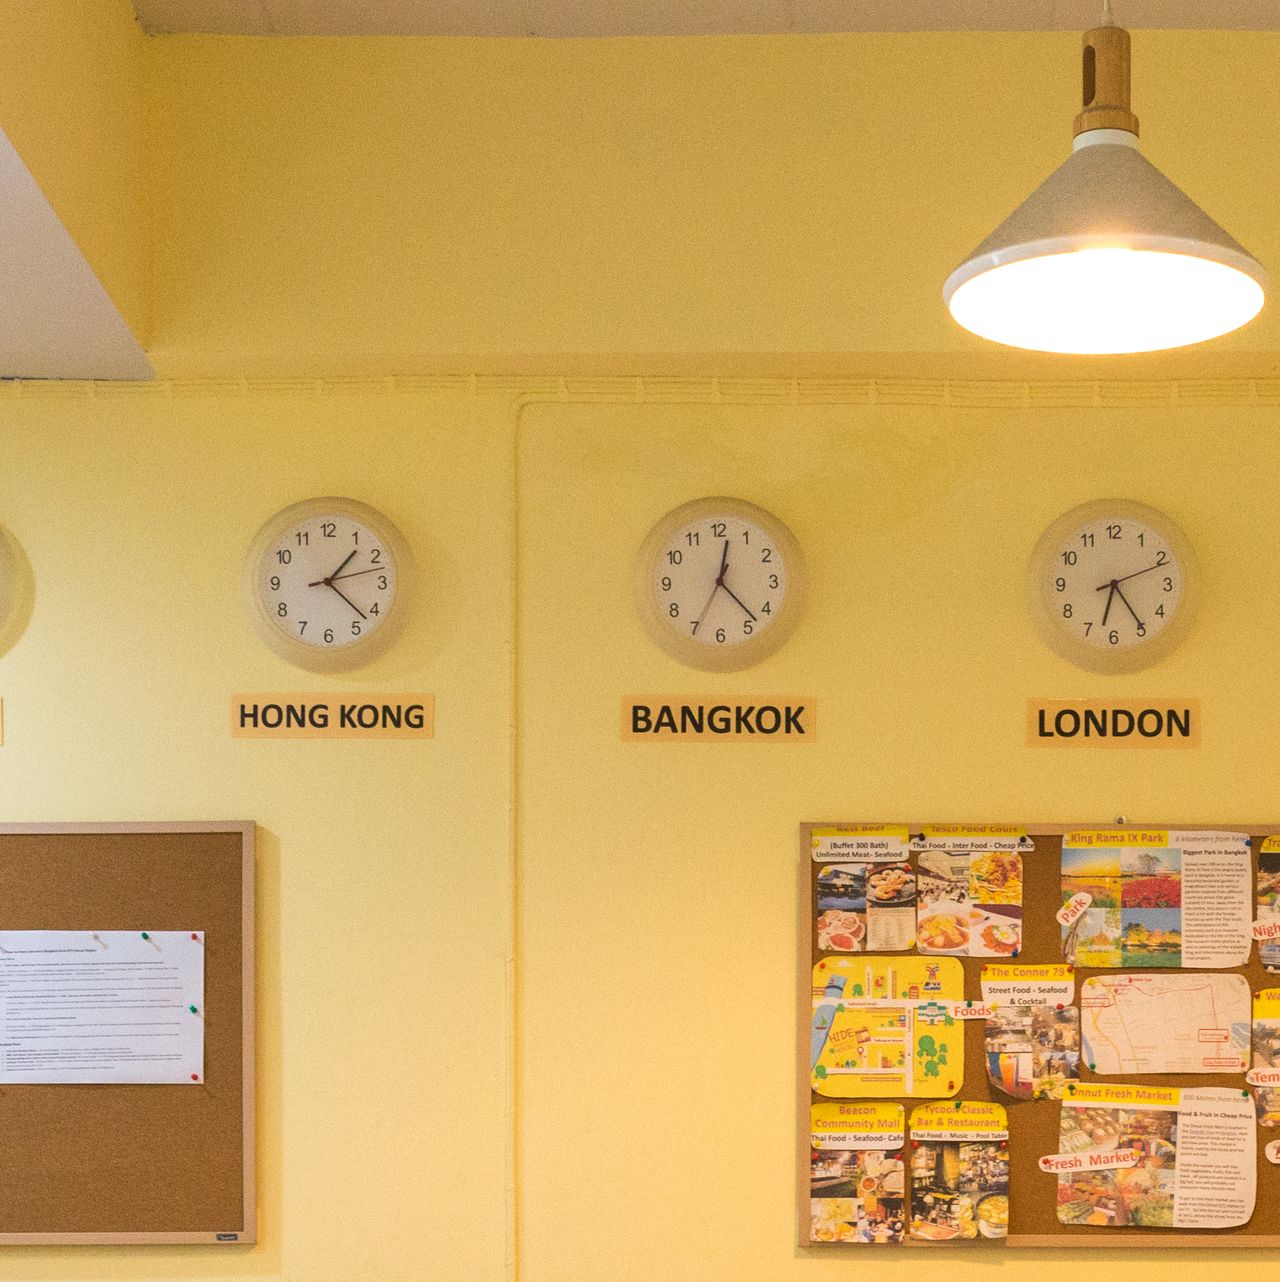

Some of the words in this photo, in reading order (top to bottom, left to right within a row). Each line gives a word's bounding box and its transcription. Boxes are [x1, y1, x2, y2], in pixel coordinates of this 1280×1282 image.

[320, 523, 336, 537] 12
[710, 523, 726, 537] 12
[1106, 525, 1122, 539] 12
[295, 532, 309, 546] 11
[352, 531, 358, 545] 1
[686, 532, 699, 546] 11
[743, 531, 749, 545] 1
[1081, 534, 1094, 547] 11
[1137, 533, 1144, 547] 1
[276, 550, 291, 564] 10
[371, 549, 381, 563] 2
[666, 550, 682, 565] 10
[762, 549, 771, 563] 2
[1061, 551, 1077, 565] 10
[1156, 551, 1166, 566] 2
[270, 576, 280, 591] 9
[378, 576, 387, 590] 3
[662, 577, 671, 591] 9
[769, 575, 778, 589] 3
[1056, 578, 1066, 592] 9
[1163, 578, 1173, 592] 3
[278, 603, 287, 617] 8
[369, 602, 380, 616] 4
[669, 603, 679, 617] 8
[761, 601, 771, 615] 4
[1063, 604, 1073, 618] 8
[1155, 604, 1165, 618] 4
[298, 621, 307, 635] 7
[351, 621, 361, 635] 5
[743, 620, 753, 634] 5
[1084, 623, 1093, 636] 7
[324, 629, 334, 643] 6
[716, 629, 726, 643] 6
[1109, 630, 1119, 645] 6
[240, 703, 329, 729] HONG
[339, 704, 424, 729] KONG
[632, 705, 806, 735] BANGKOK
[1038, 708, 1190, 738] LONDON
[1072, 834, 1093, 844] King
[1097, 834, 1124, 842] Rama
[1128, 834, 1138, 842] IX
[1141, 834, 1163, 842] Park
[1061, 899, 1086, 923] Park
[991, 967, 1009, 976] The
[1013, 967, 1049, 976] Conner
[1053, 968, 1065, 976] 79
[1038, 986, 1068, 994] Seafood
[954, 1005, 992, 1016] Foods
[829, 1028, 855, 1043] HIDE
[1105, 1089, 1132, 1098] Fresh
[1136, 1090, 1172, 1101] Market
[839, 1106, 876, 1115] Beacon
[961, 1105, 993, 1114] Classic
[815, 1119, 874, 1129] Community
[917, 1118, 933, 1126] Bar
[936, 1118, 944, 1126] &
[947, 1118, 1000, 1127] Restaurant
[888, 1134, 905, 1142] Cafe
[1048, 1157, 1082, 1170] Fresh
[1089, 1152, 1137, 1166] Market
